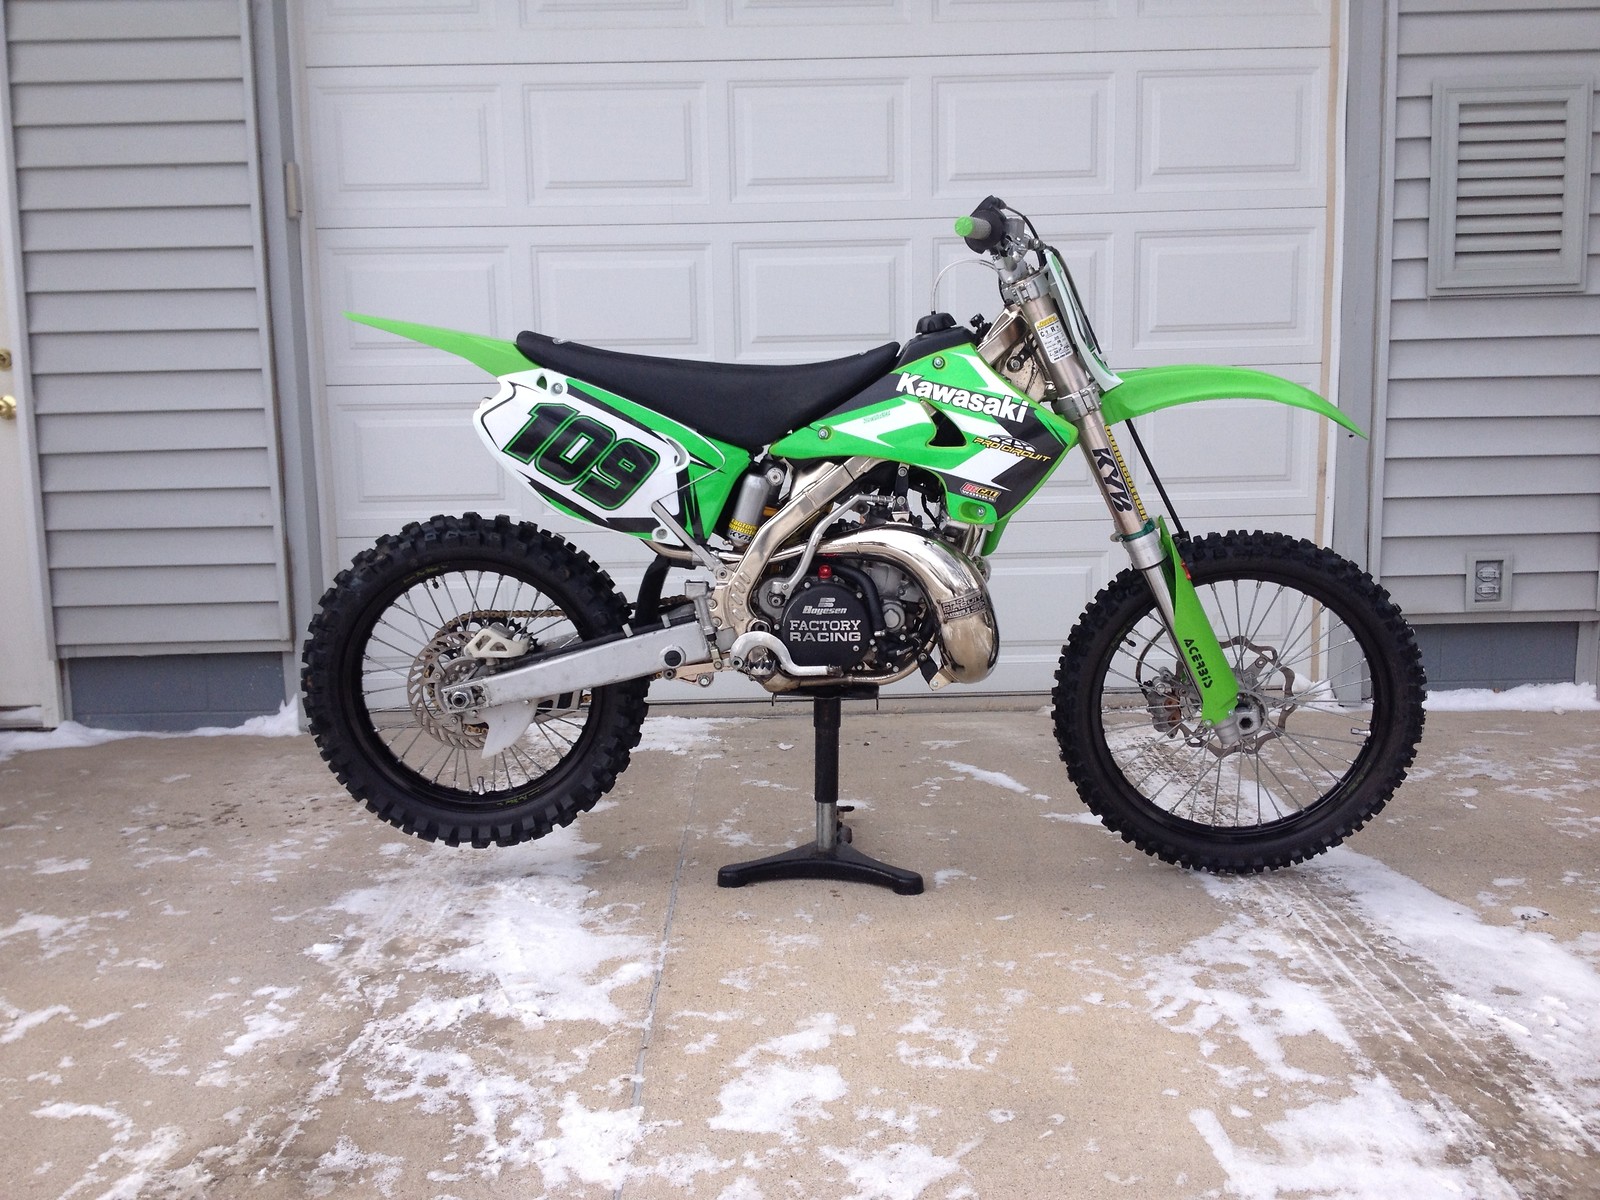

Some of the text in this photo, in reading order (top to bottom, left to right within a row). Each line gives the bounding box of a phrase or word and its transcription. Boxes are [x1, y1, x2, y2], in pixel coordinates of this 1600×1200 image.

[896, 371, 1030, 424] Kawasaki
[501, 402, 660, 510] 109
[973, 436, 1052, 462] PRO CIRCUIT
[1091, 447, 1133, 513] KYB
[789, 619, 862, 631] FACTORY
[802, 605, 847, 616] Boyesen
[789, 632, 861, 642] RACING
[1183, 638, 1213, 689] ACERBIS
